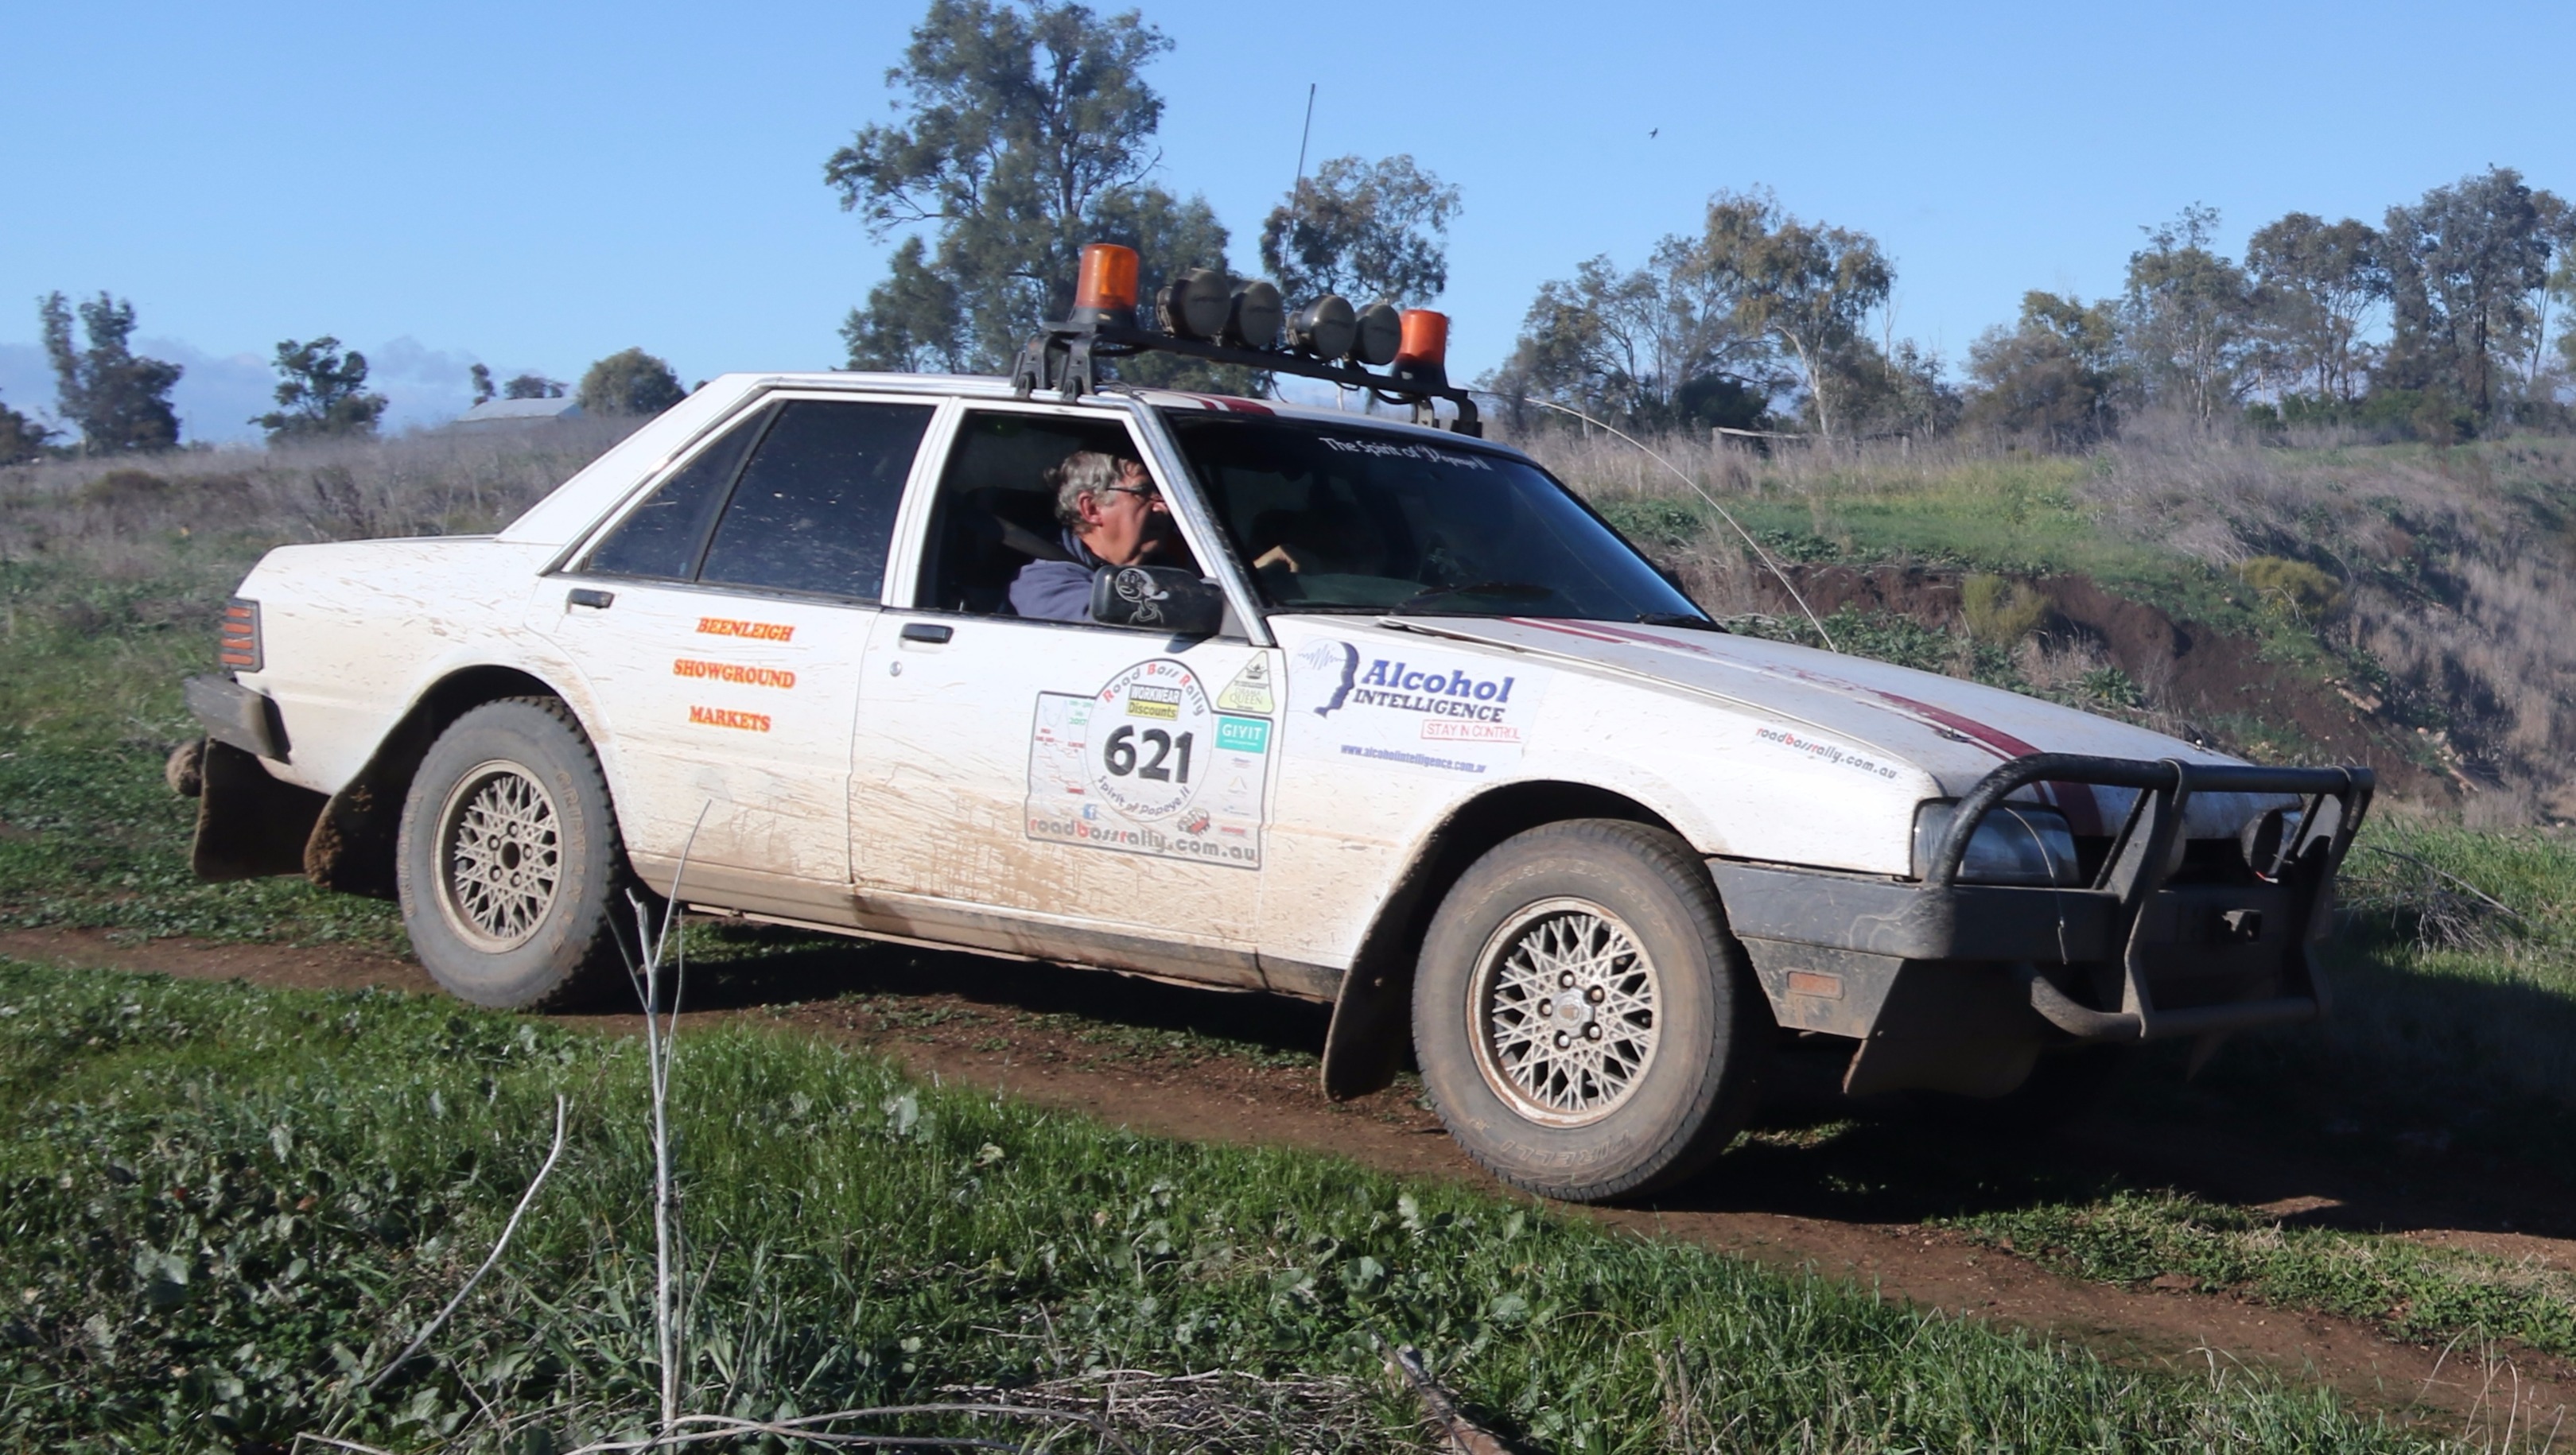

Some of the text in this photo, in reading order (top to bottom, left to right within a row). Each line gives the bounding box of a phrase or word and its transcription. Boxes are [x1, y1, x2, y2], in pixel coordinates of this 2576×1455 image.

[1319, 436, 1360, 452] The
[1357, 440, 1403, 457] Spirit
[1401, 447, 1421, 458] of
[696, 616, 795, 642] BEENLEIGH
[673, 658, 796, 689] SHOWGROUND
[1361, 659, 1515, 703] Alcohol
[1103, 663, 1205, 717] Road Boss Rally
[1130, 685, 1181, 704] WORKWEAR
[1229, 693, 1264, 706] QUEEN
[689, 704, 771, 732] MARKETS
[1128, 703, 1177, 720] Discounts
[1352, 688, 1506, 723] INTELLIGENCE
[1426, 723, 1457, 737] STAY
[1472, 724, 1521, 739] CONTROL
[1104, 724, 1193, 784] 621
[1340, 744, 1486, 773] www.alcoholintelligence.com.au
[1756, 728, 1898, 779] roadbossrally.com.au
[1098, 775, 1126, 808] Spirit
[1139, 797, 1182, 816] Popeye
[1030, 818, 1256, 861] roadbossrally.com.au
